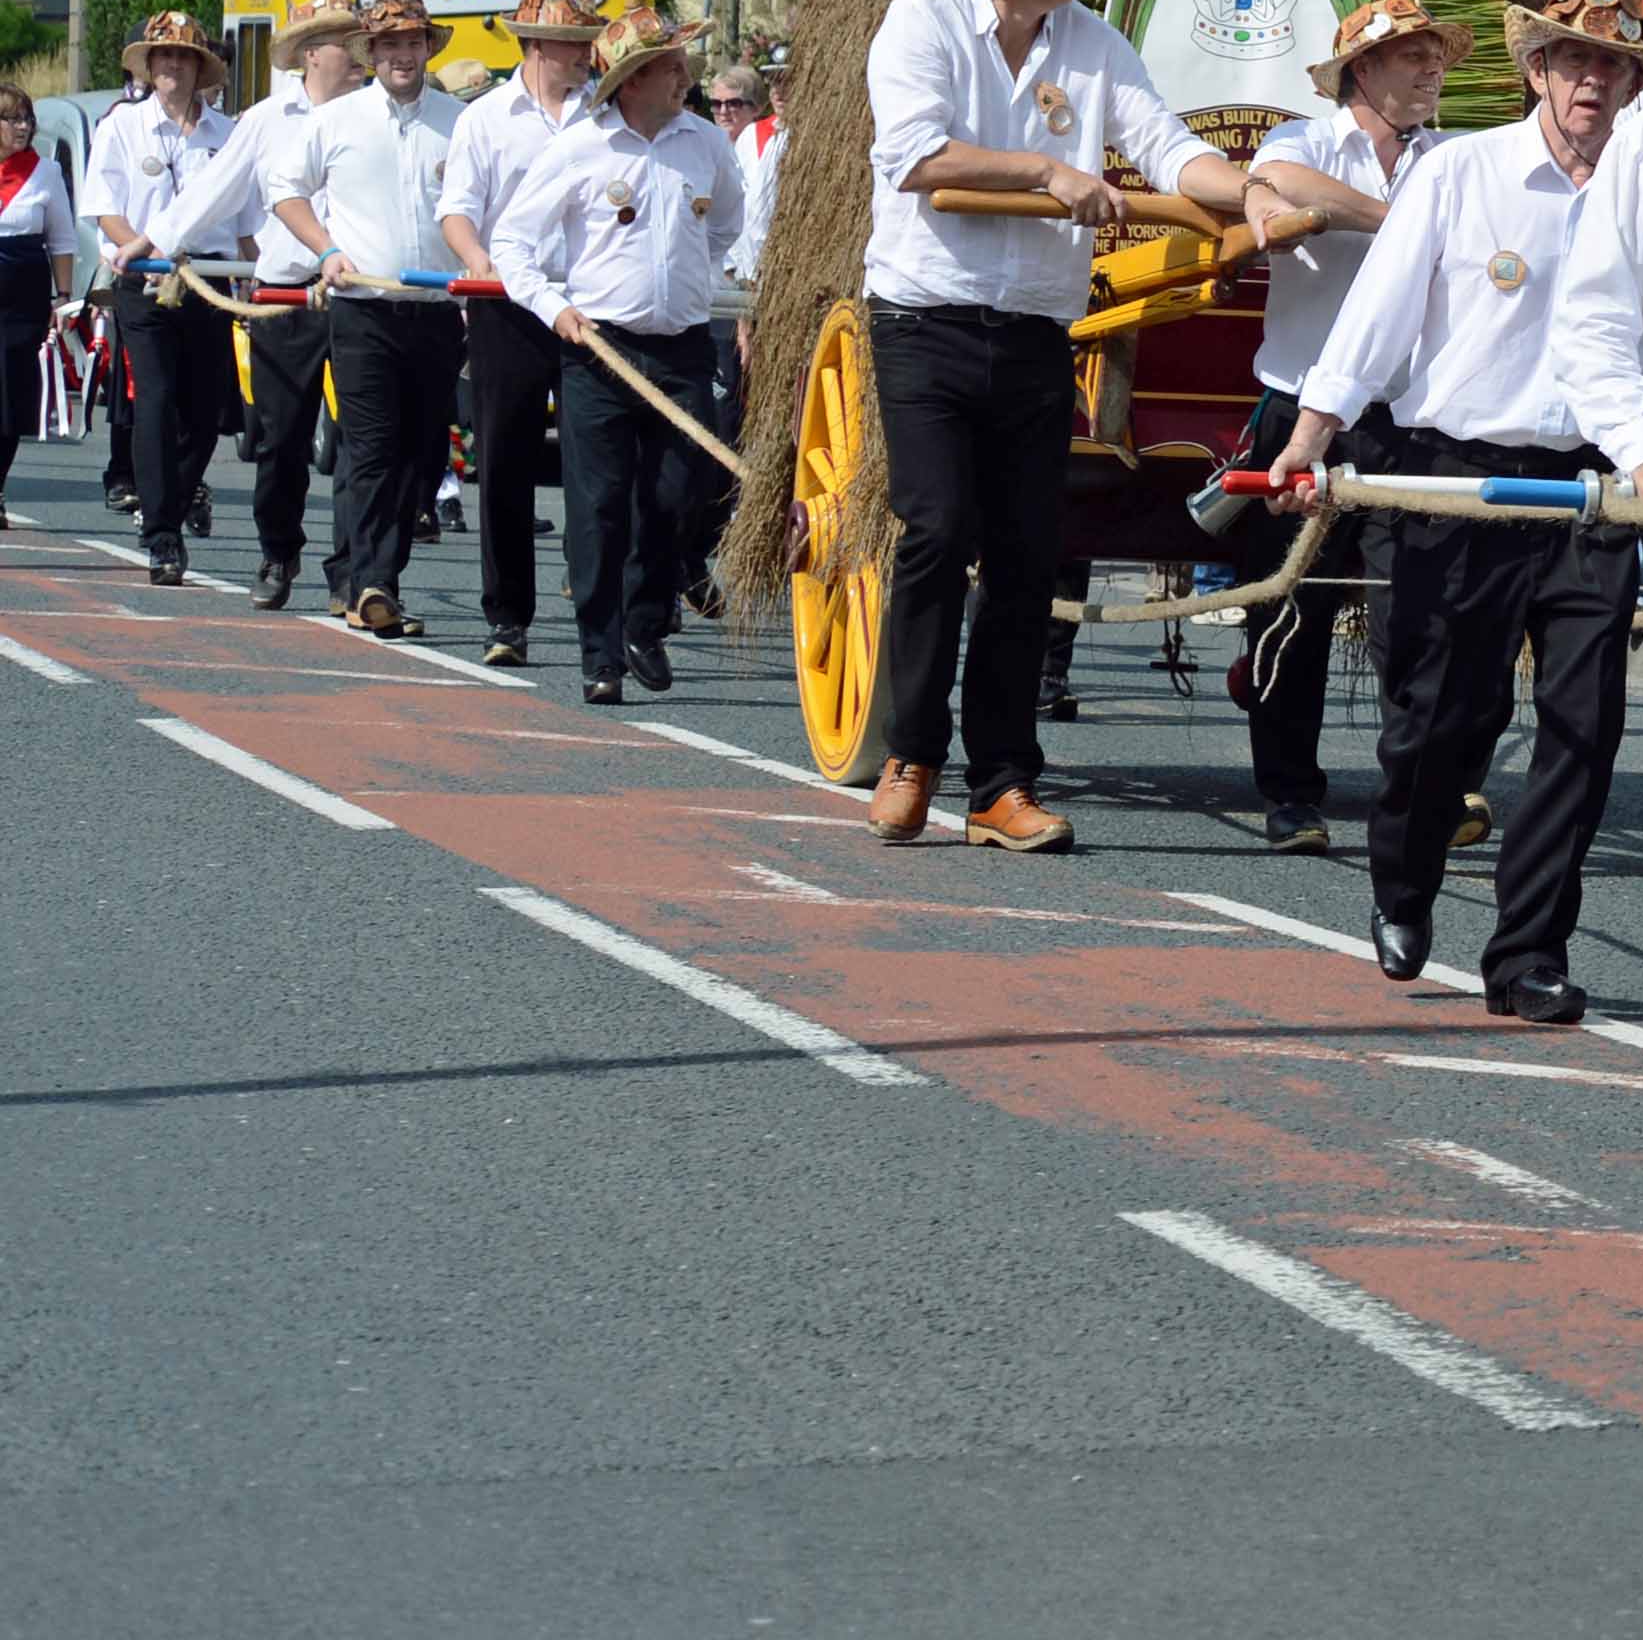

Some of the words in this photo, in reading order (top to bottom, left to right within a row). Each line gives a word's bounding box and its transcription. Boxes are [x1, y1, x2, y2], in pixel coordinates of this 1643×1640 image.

[1187, 112, 1220, 132] WAS
[1222, 109, 1266, 127] BUILT
[1119, 173, 1145, 187] AND
